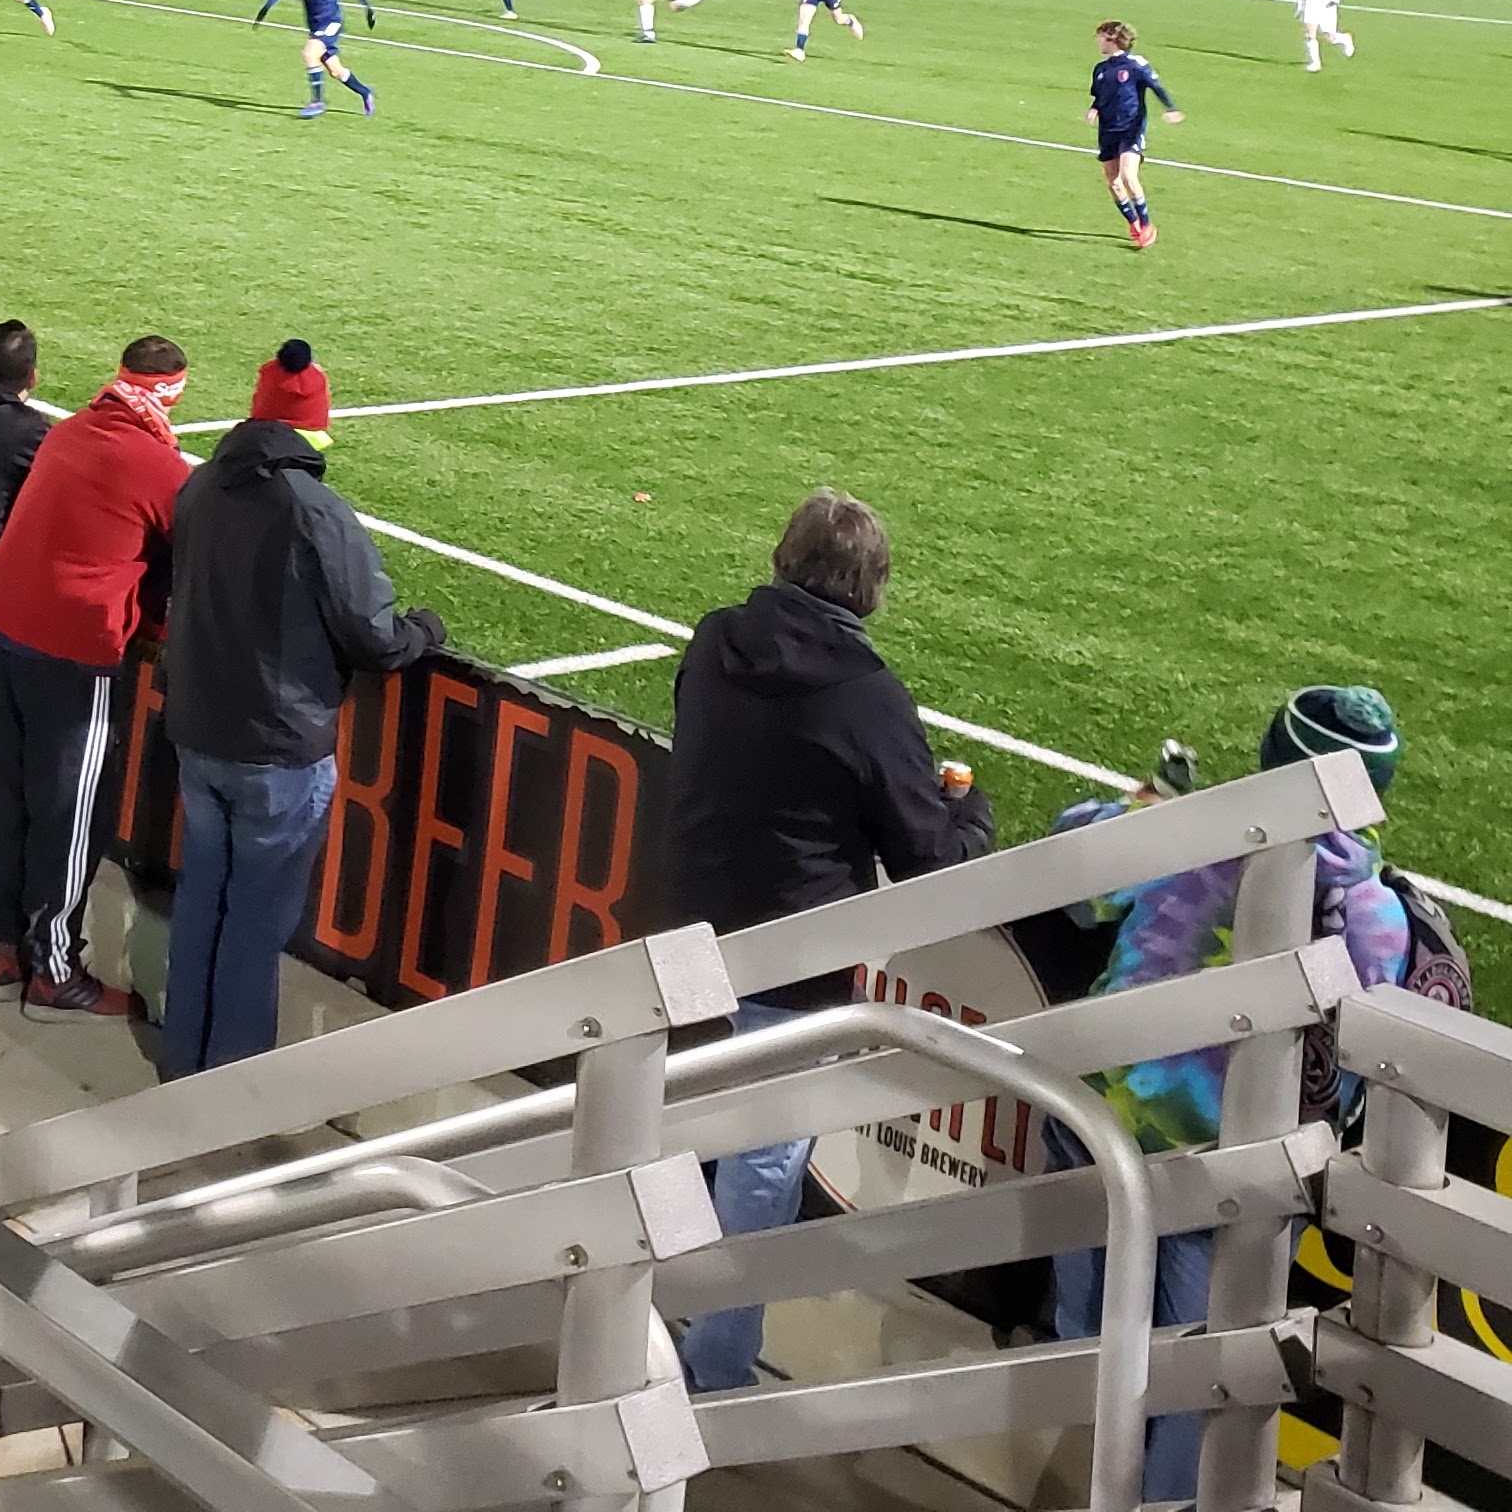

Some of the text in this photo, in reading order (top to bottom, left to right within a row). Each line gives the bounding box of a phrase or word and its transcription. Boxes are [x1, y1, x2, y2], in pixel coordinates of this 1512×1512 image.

[314, 671, 639, 1000] BEER
[877, 1121, 989, 1189] LOUIS BREWERY
